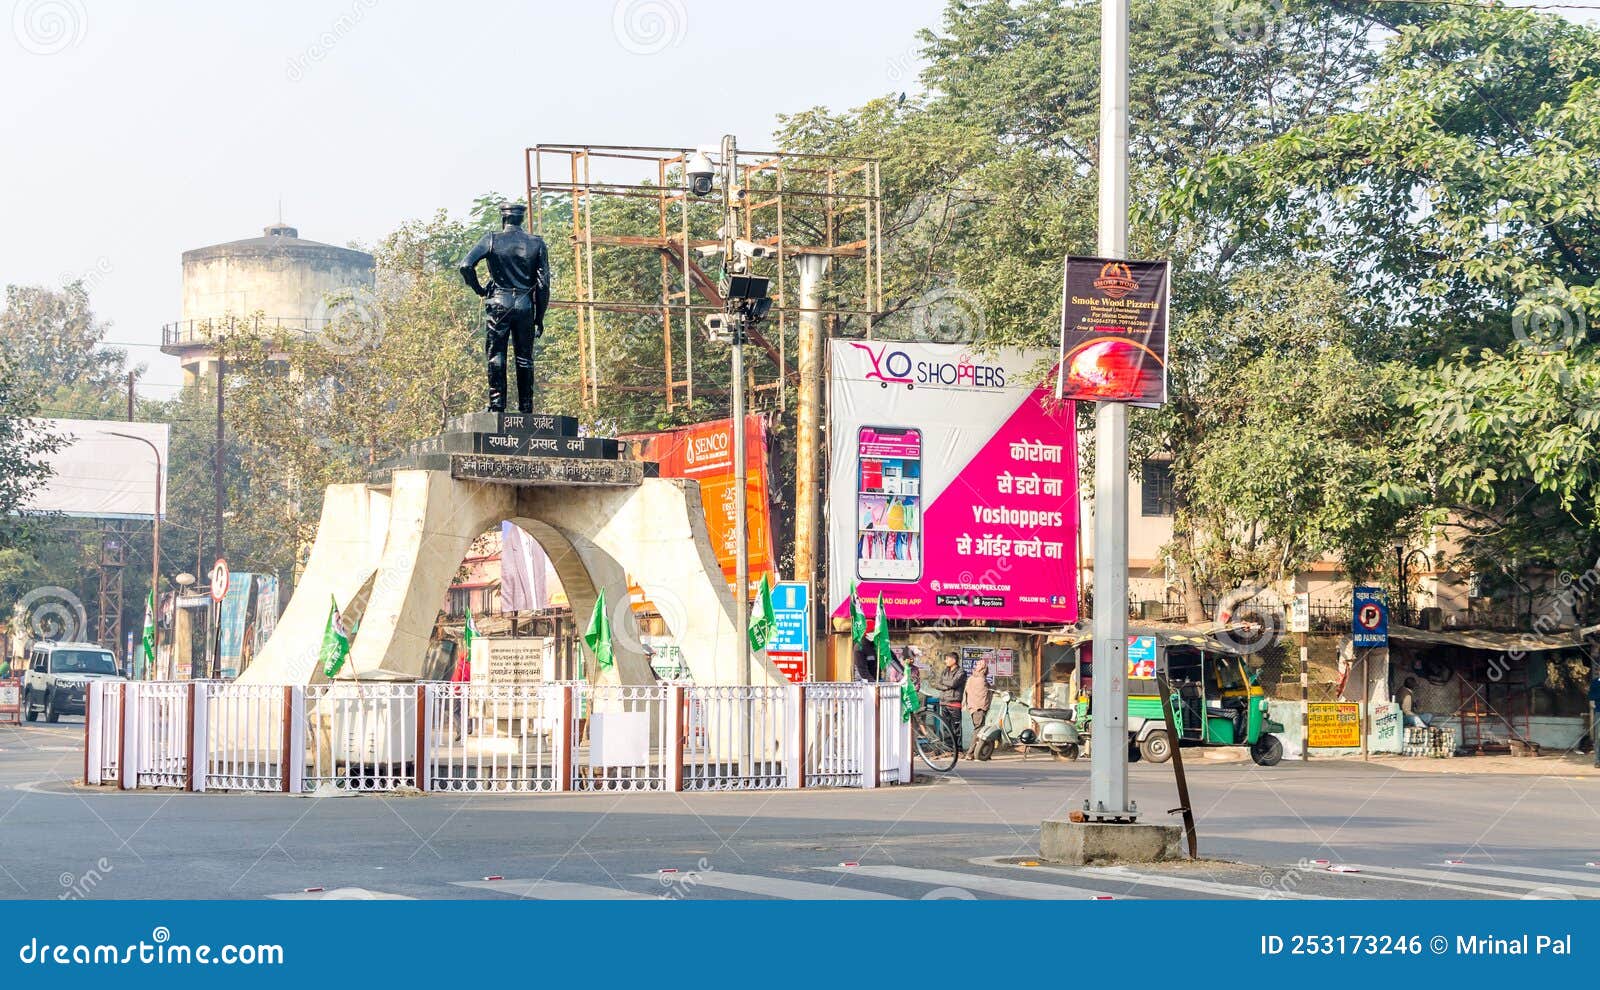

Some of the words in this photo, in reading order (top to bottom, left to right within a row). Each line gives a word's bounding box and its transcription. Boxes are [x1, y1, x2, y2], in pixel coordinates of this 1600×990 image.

[1071, 296, 1100, 306] Smoke
[1101, 298, 1124, 307] Wood
[1126, 300, 1159, 310] Pizzeria
[917, 361, 1005, 388] SHOPPERS
[503, 416, 523, 429] अमर
[489, 434, 519, 448] रणधीर
[530, 438, 558, 451] प्रसाद
[567, 438, 585, 451] वर्मा
[695, 432, 728, 455] SENCO
[1008, 438, 1063, 463] कोरोना
[996, 470, 1013, 494] से
[1015, 472, 1041, 495] डरो
[1042, 477, 1063, 496] ना
[972, 505, 1063, 528] Yoshoppers
[956, 533, 972, 555] से
[975, 533, 1012, 557] ऑर्डर
[1013, 536, 1042, 558] करो
[1043, 542, 1063, 559] ना
[943, 583, 1011, 592] WWW.YOSHOPPERS.COM
[1354, 633, 1363, 642] NO
[1363, 633, 1386, 642] PARKING
